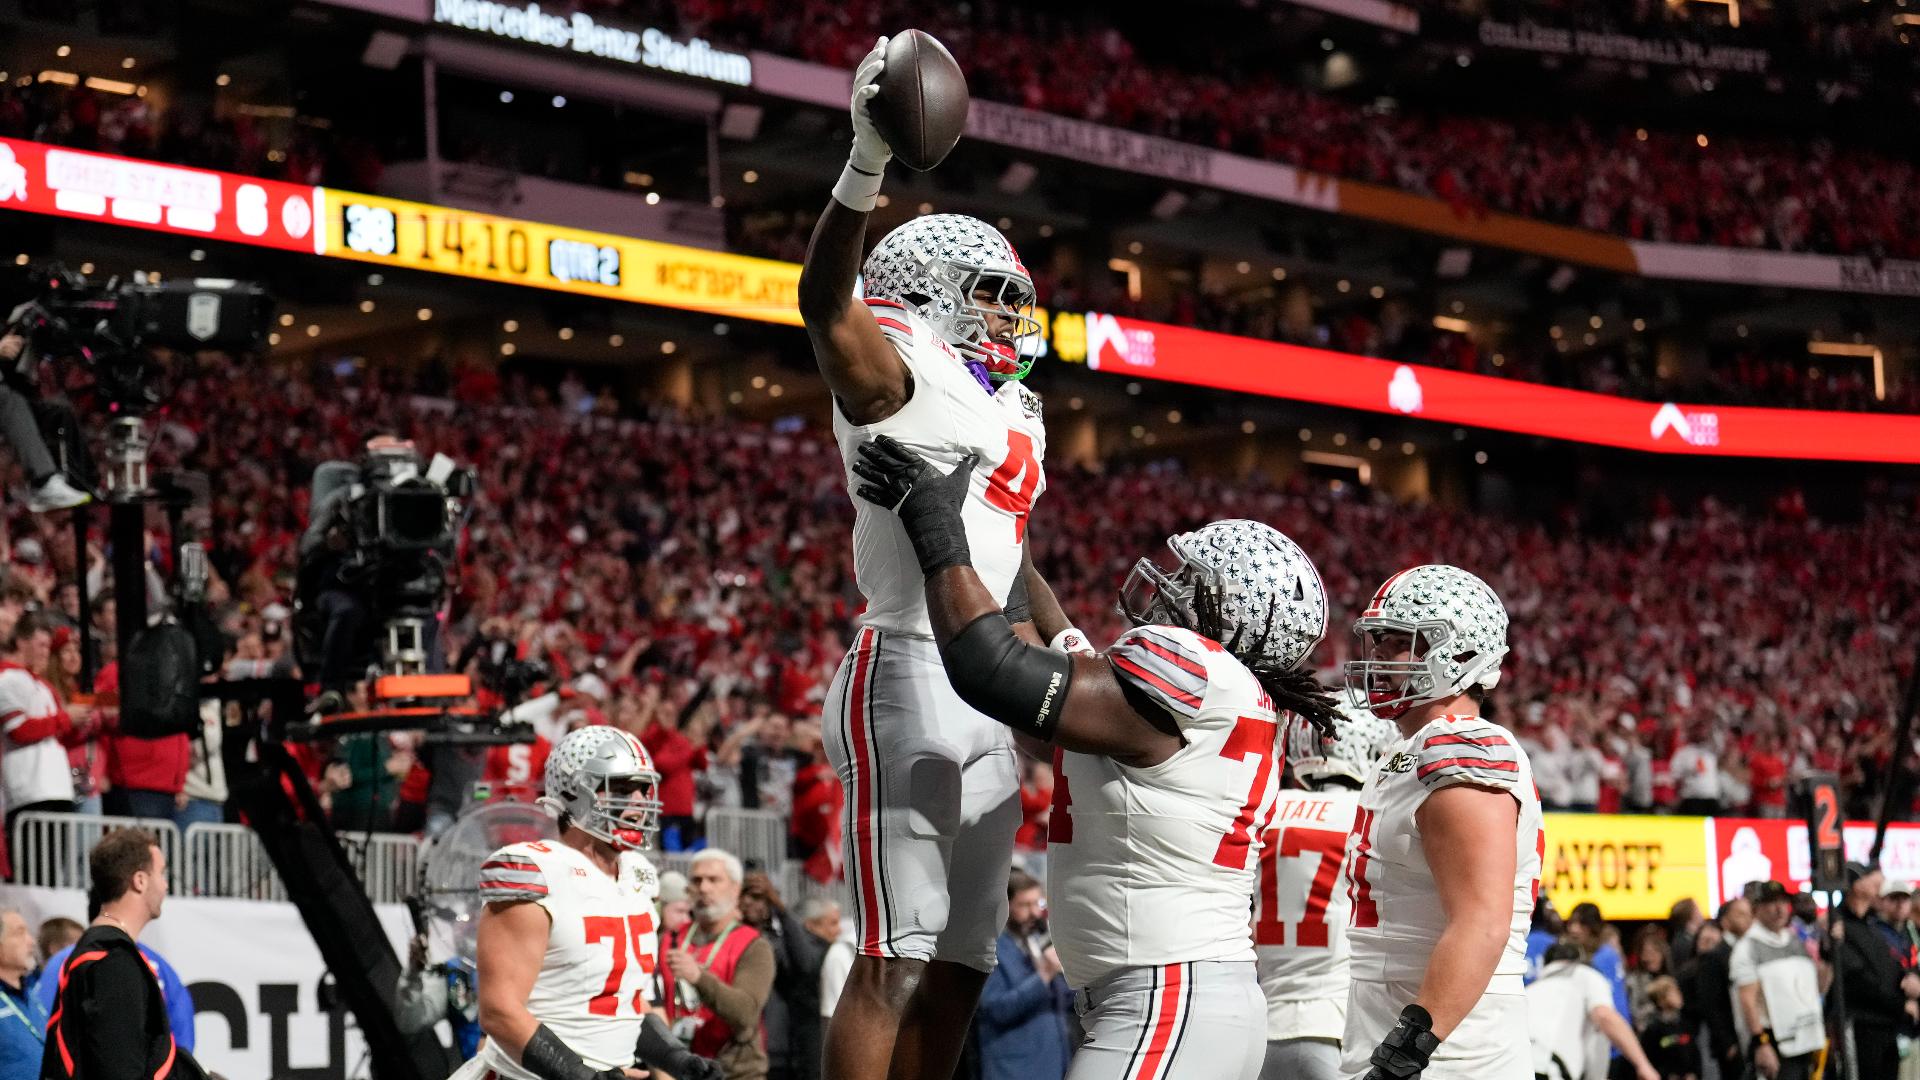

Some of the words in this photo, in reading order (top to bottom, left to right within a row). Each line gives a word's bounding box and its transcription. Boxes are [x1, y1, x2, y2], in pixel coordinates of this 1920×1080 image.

[642, 27, 751, 86] Stadium
[418, 213, 529, 274] 14:10
[984, 428, 1040, 545] 4
[1035, 672, 1062, 727] Mueller
[1212, 715, 1287, 870] 7
[1280, 800, 1333, 823] TATE
[1814, 784, 1840, 848] 2
[1256, 826, 1349, 948] 17
[1541, 842, 1662, 891] AYOFF
[583, 912, 656, 1017] 75
